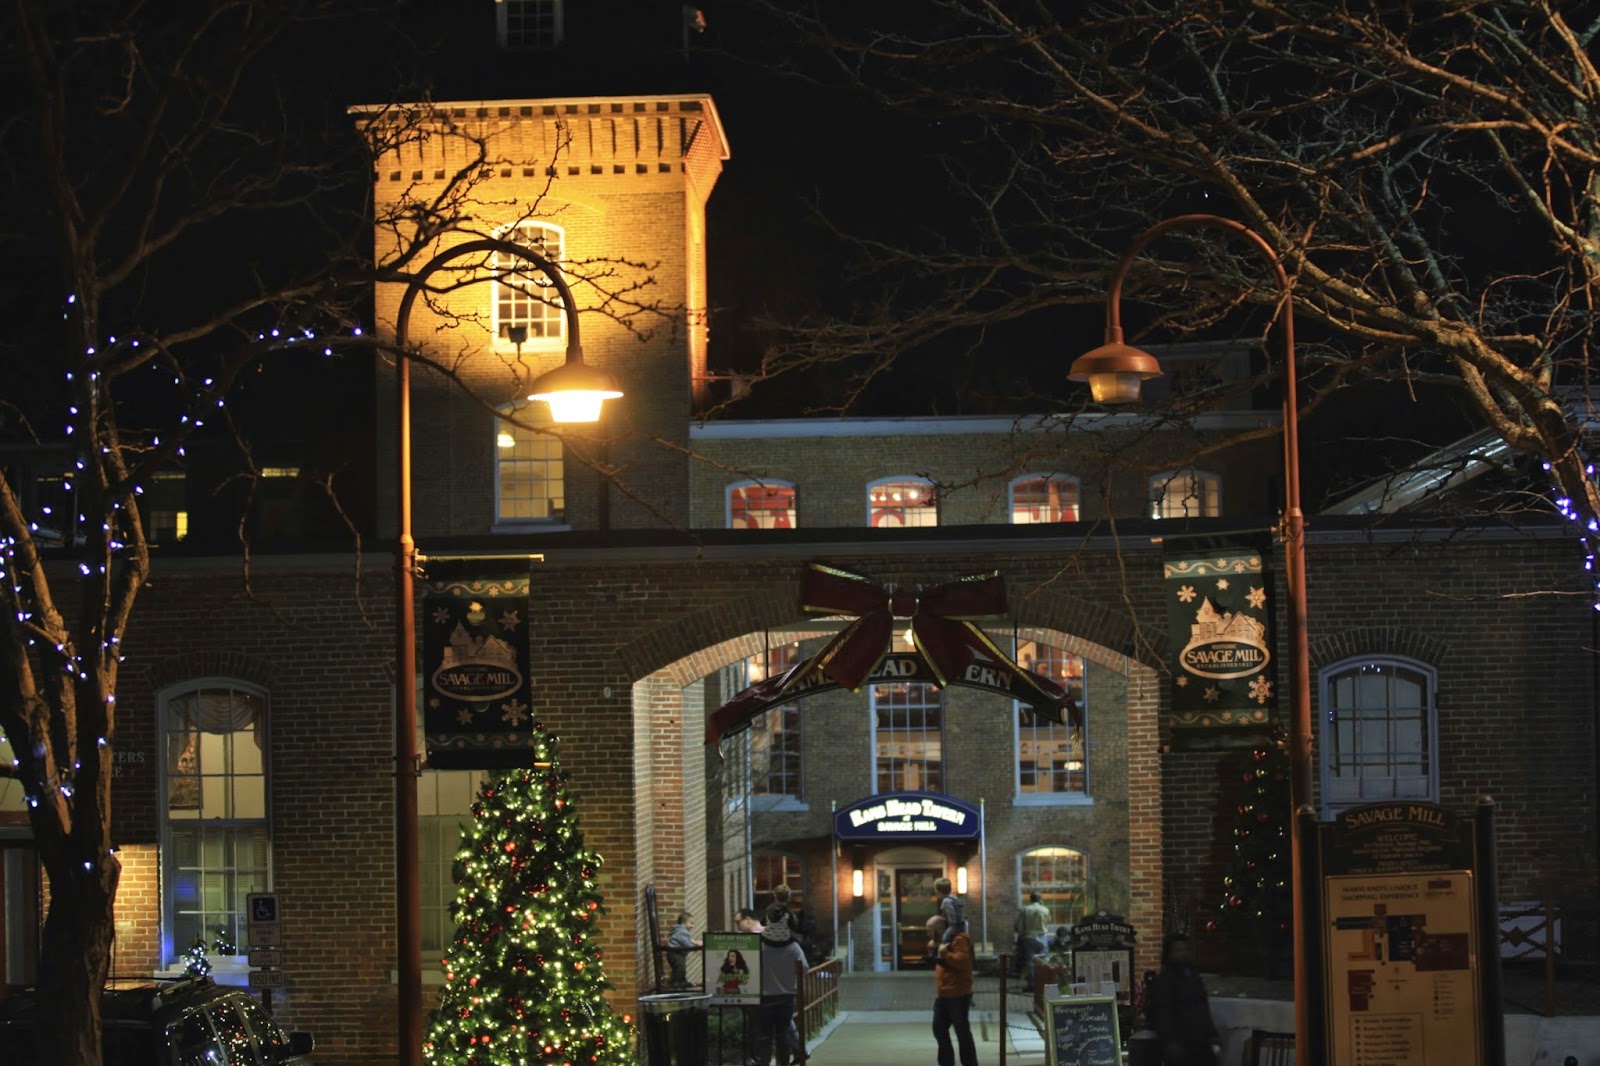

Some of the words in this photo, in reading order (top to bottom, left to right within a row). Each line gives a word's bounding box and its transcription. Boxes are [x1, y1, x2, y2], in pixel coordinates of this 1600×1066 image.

[1187, 650, 1234, 664] SAVAGE
[1234, 649, 1263, 662] MILL
[439, 673, 485, 686] SAVAGE
[487, 673, 515, 685] MILL
[849, 804, 887, 828] RAMS
[886, 799, 922, 817] HEAD
[922, 799, 966, 826] TAVERN
[1345, 807, 1403, 829] SAVAGE
[1408, 806, 1446, 826] MILL
[877, 821, 913, 832] SAVAGE
[914, 821, 937, 831] MILL
[1074, 926, 1092, 935] RAMS
[1092, 923, 1109, 931] HEAD
